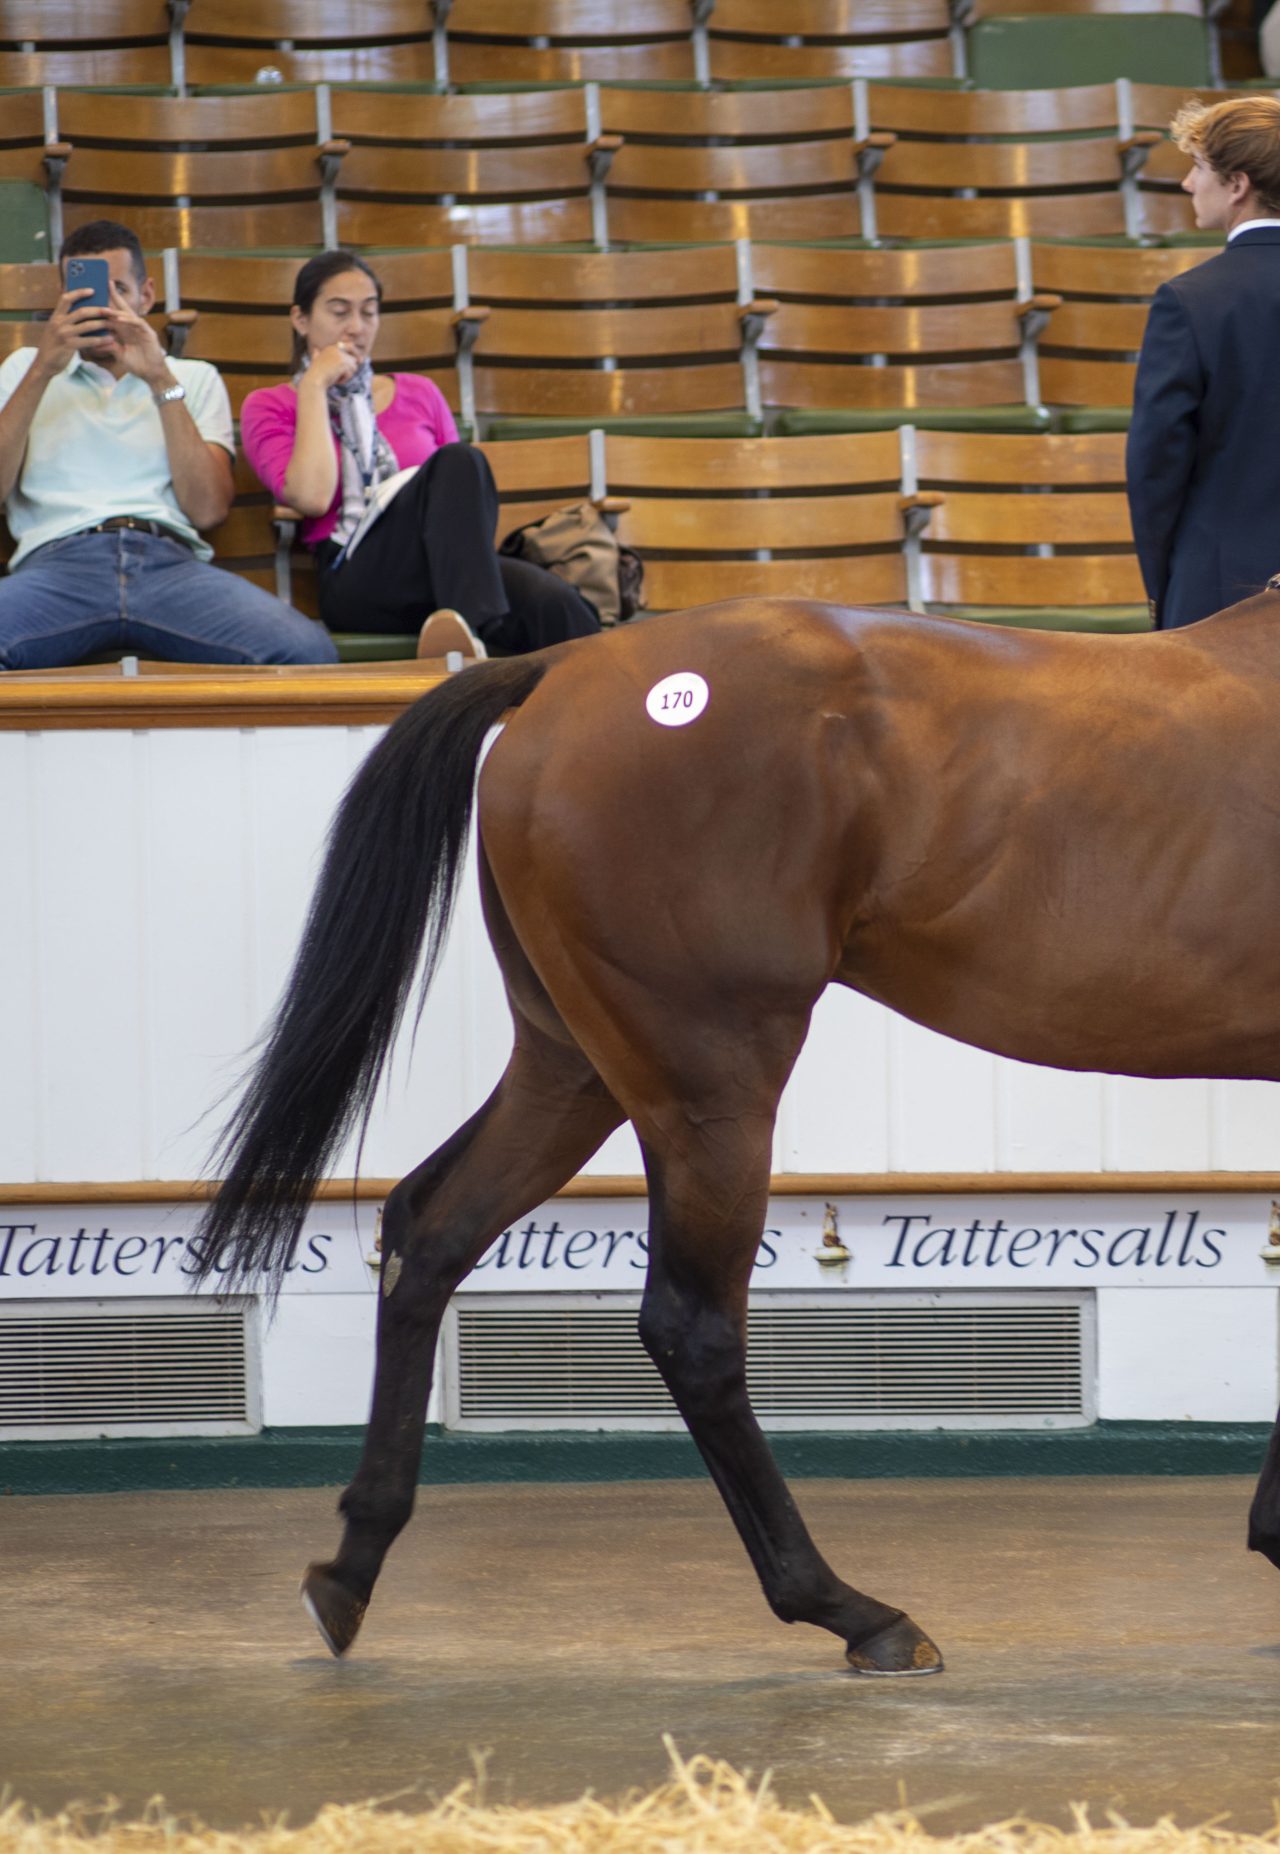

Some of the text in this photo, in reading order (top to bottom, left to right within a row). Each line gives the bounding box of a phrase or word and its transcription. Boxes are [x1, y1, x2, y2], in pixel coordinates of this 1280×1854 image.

[661, 690, 693, 710] 170
[473, 1221, 783, 1269] atterss
[882, 1210, 1227, 1268] Tattersalls
